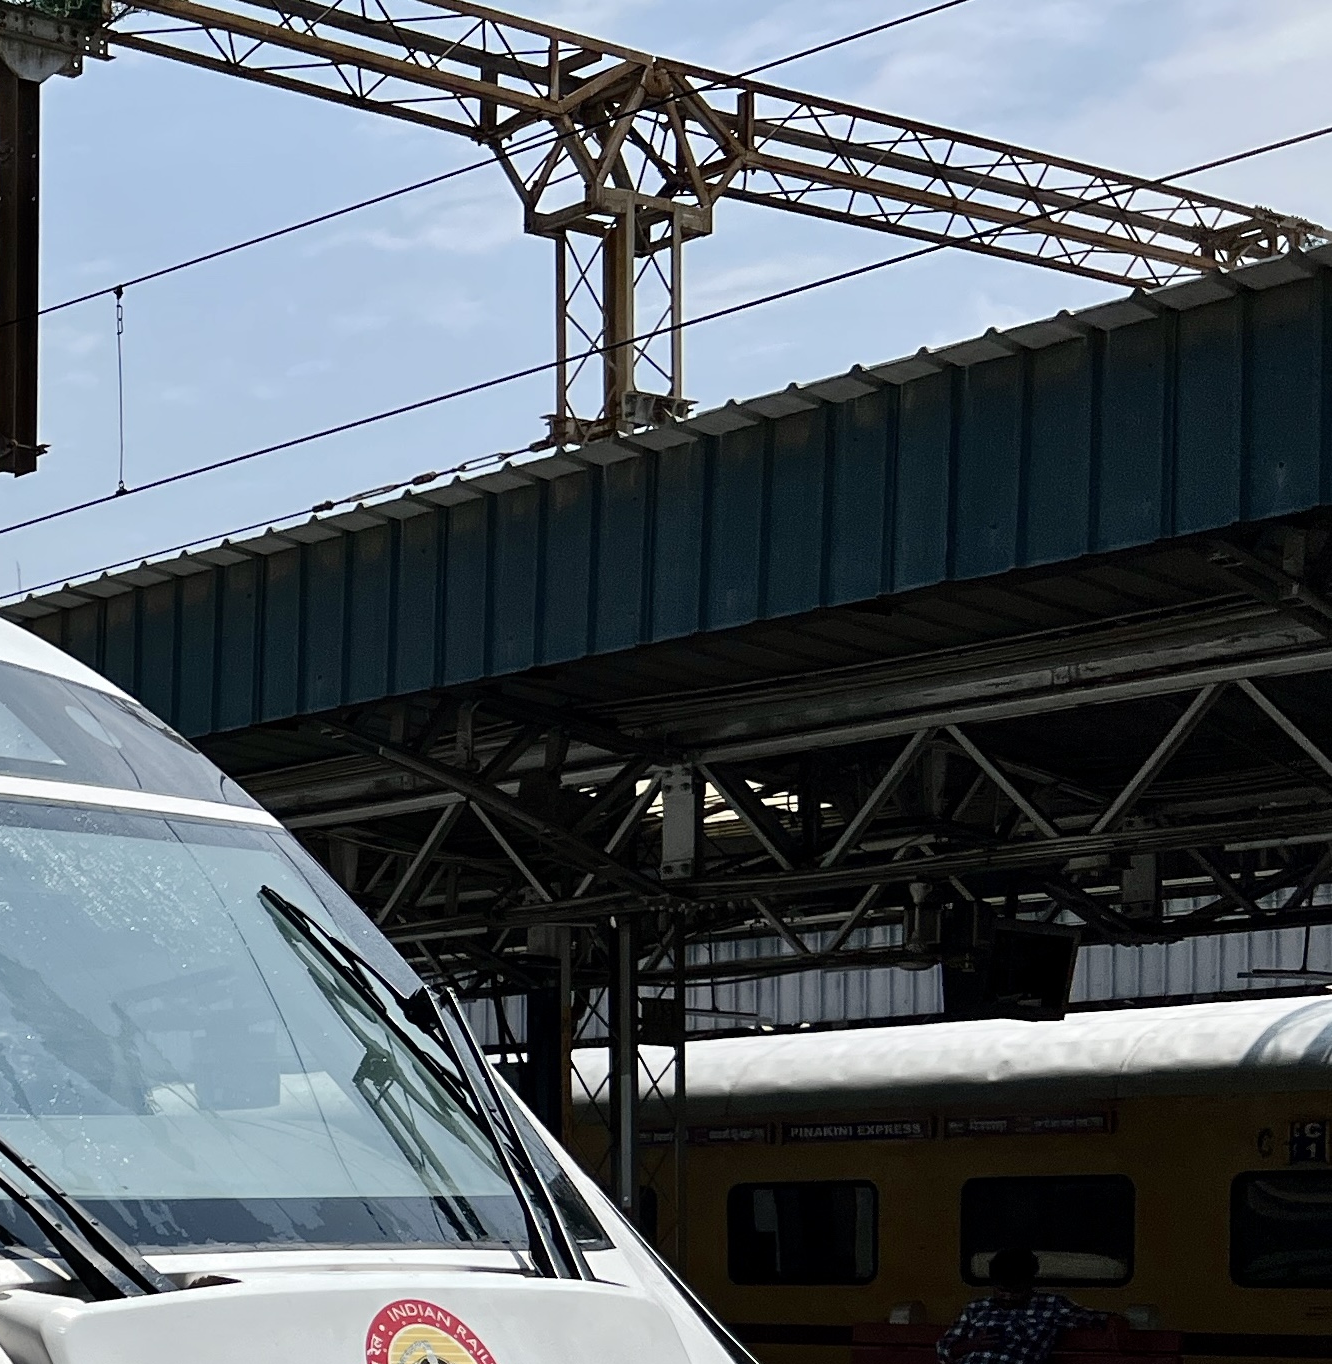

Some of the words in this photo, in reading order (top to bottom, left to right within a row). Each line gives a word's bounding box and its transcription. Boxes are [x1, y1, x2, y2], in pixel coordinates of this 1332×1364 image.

[790, 1125, 853, 1138] PINAKINI
[856, 1122, 922, 1136] EXPRESS
[387, 1303, 451, 1328] INDIAN
